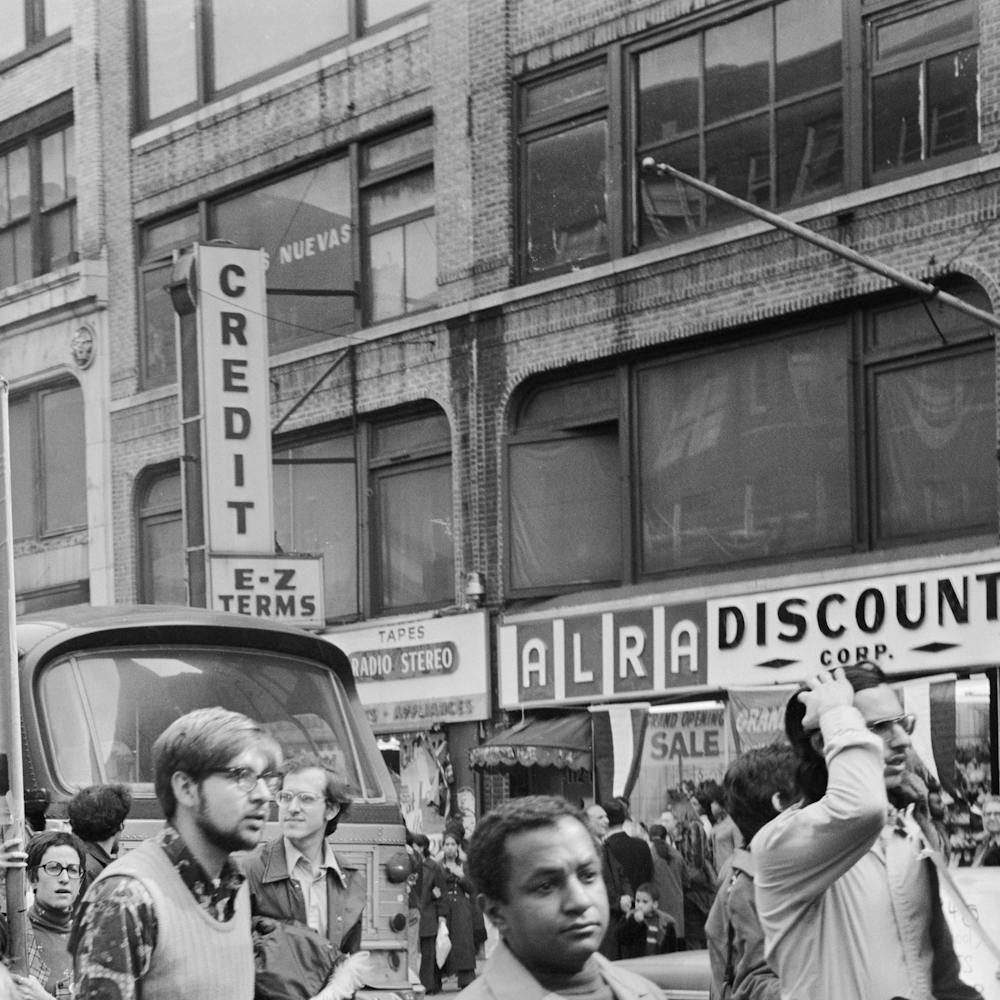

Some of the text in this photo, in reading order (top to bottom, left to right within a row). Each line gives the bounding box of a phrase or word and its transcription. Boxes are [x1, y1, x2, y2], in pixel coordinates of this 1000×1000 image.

[280, 223, 352, 264] NUEVAS
[219, 263, 255, 536] CREDIT
[234, 568, 296, 591] E-Z
[218, 594, 316, 617] TERMS
[378, 626, 425, 643] TAPES
[521, 572, 1000, 689] ALRA DISCOUNT
[351, 647, 453, 677] RADIO STEREO
[820, 644, 894, 666] CORP.
[650, 730, 720, 760] SALE
